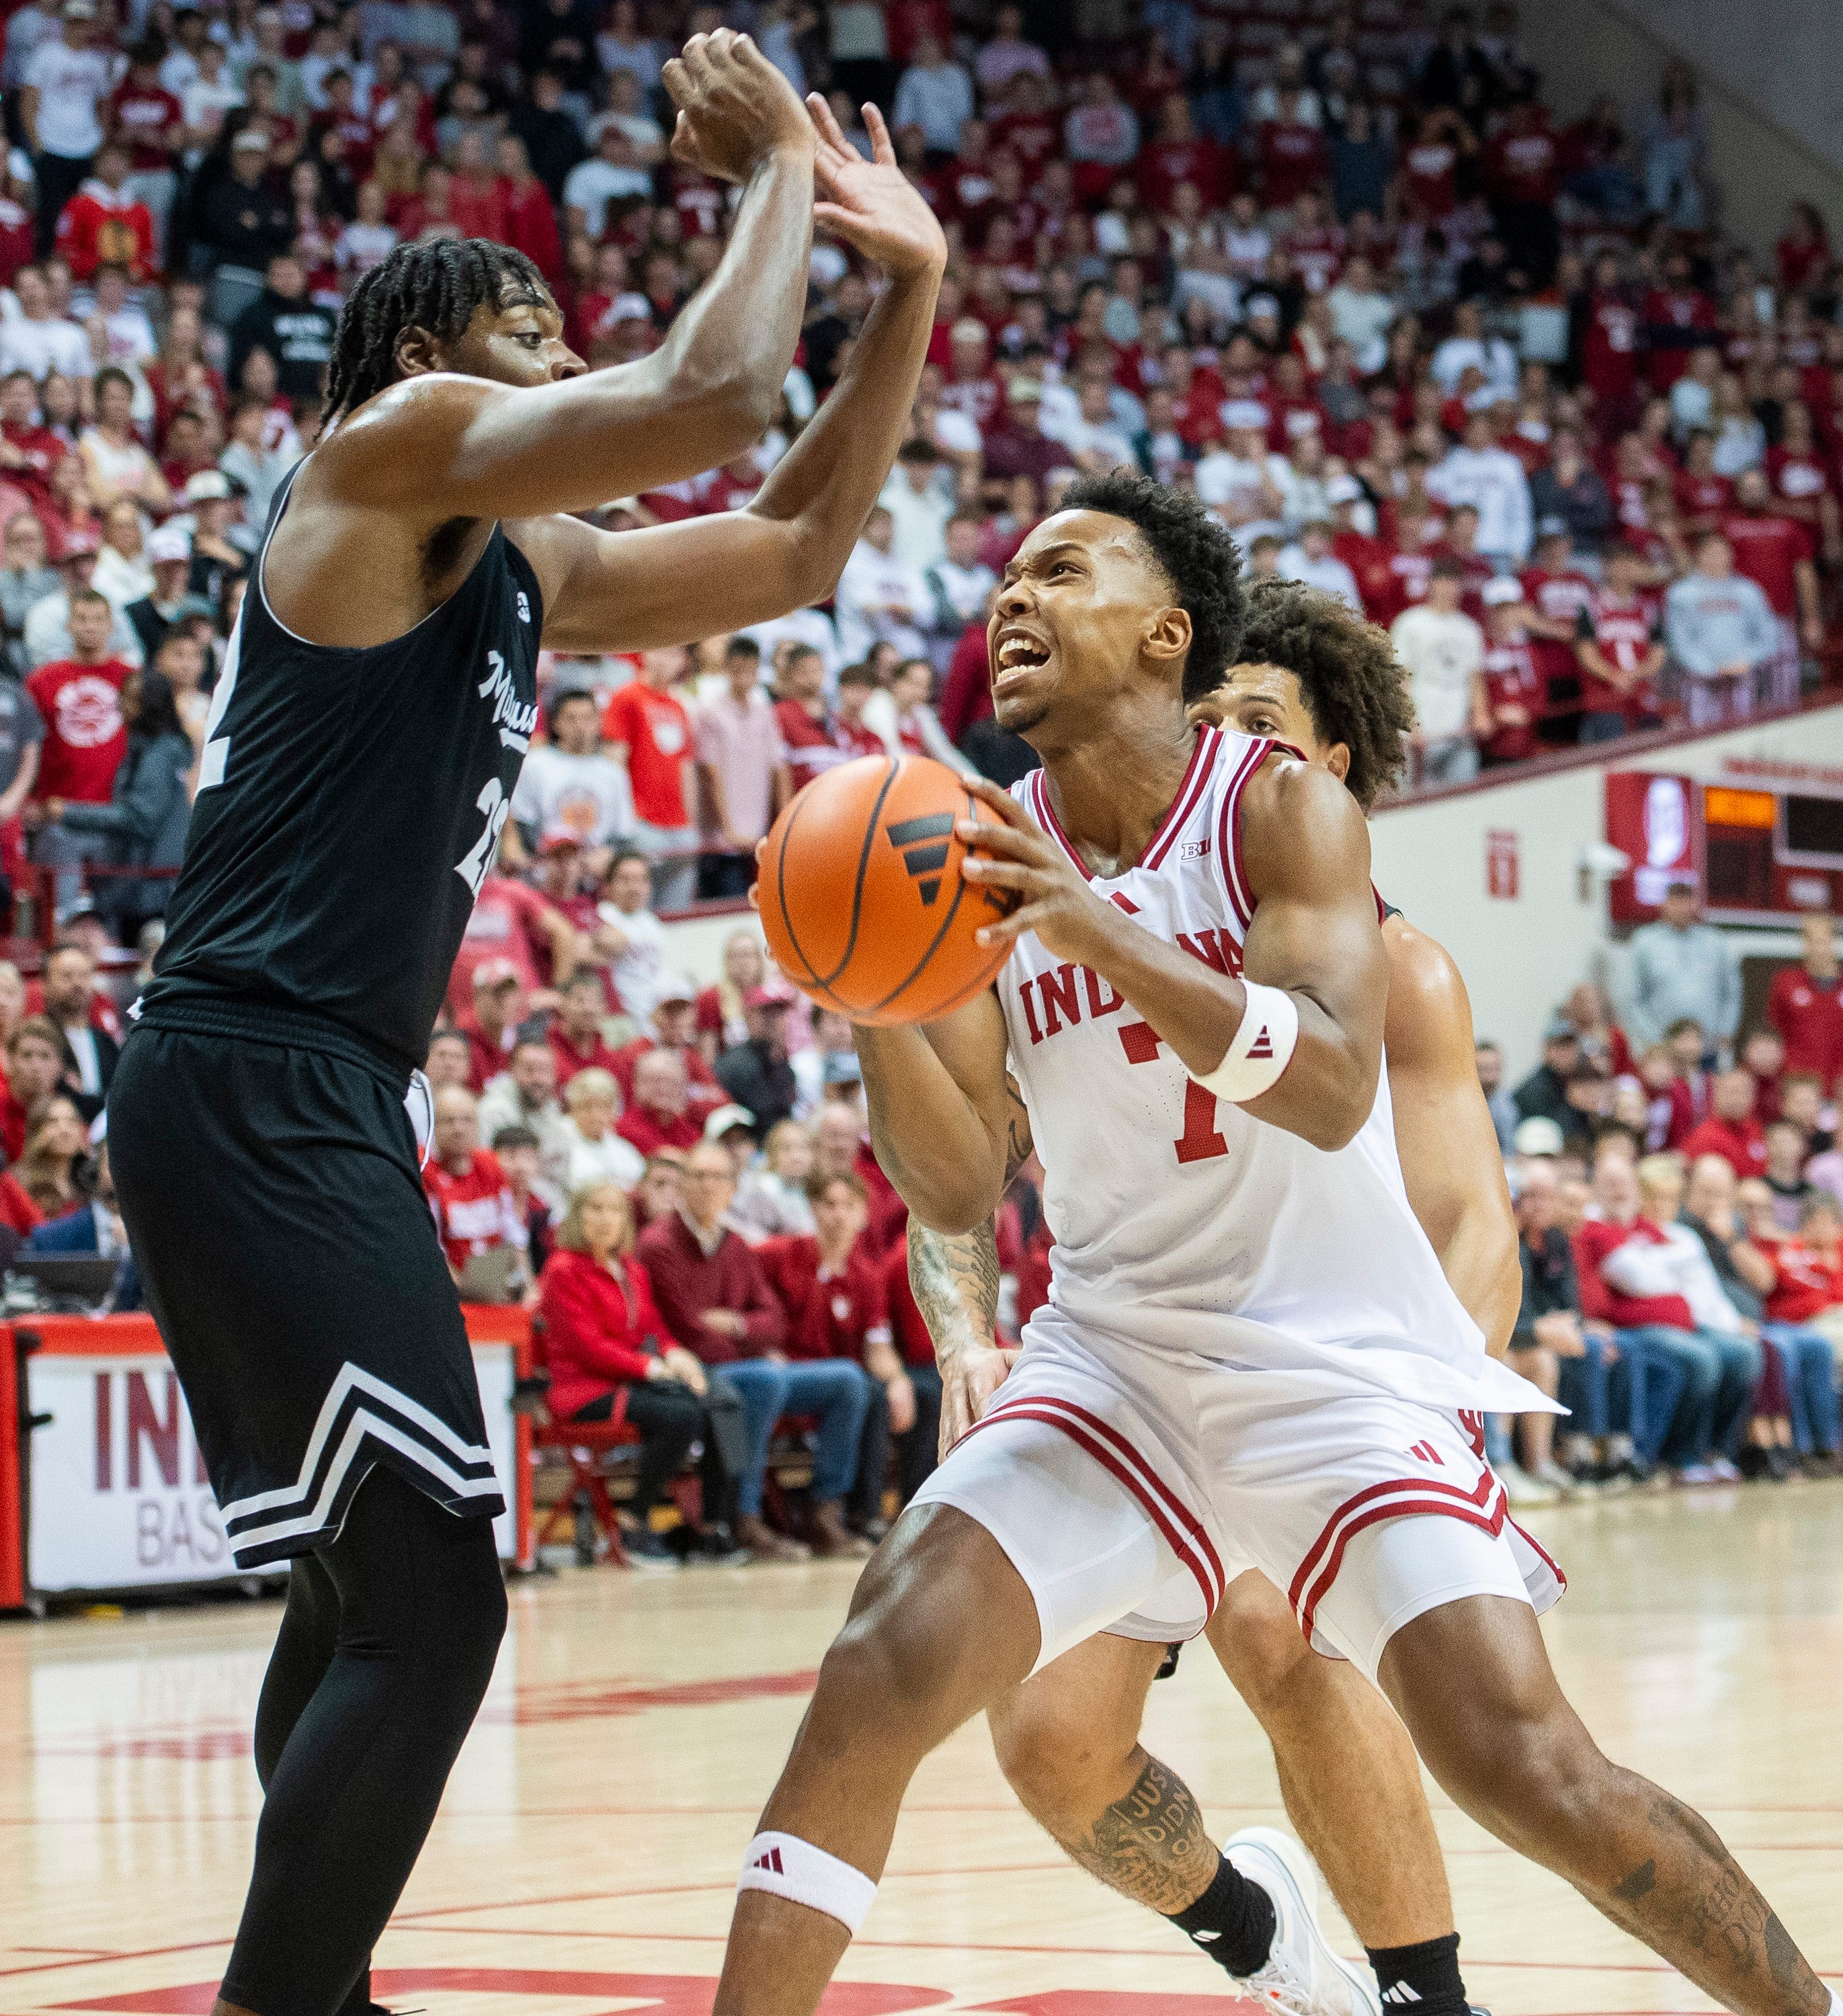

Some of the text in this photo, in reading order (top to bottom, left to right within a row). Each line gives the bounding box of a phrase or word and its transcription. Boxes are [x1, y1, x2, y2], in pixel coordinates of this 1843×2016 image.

[1019, 929, 1244, 1046] INDNA
[1131, 1766, 1169, 1818] JUS
[1142, 1783, 1190, 1843] DIDN
